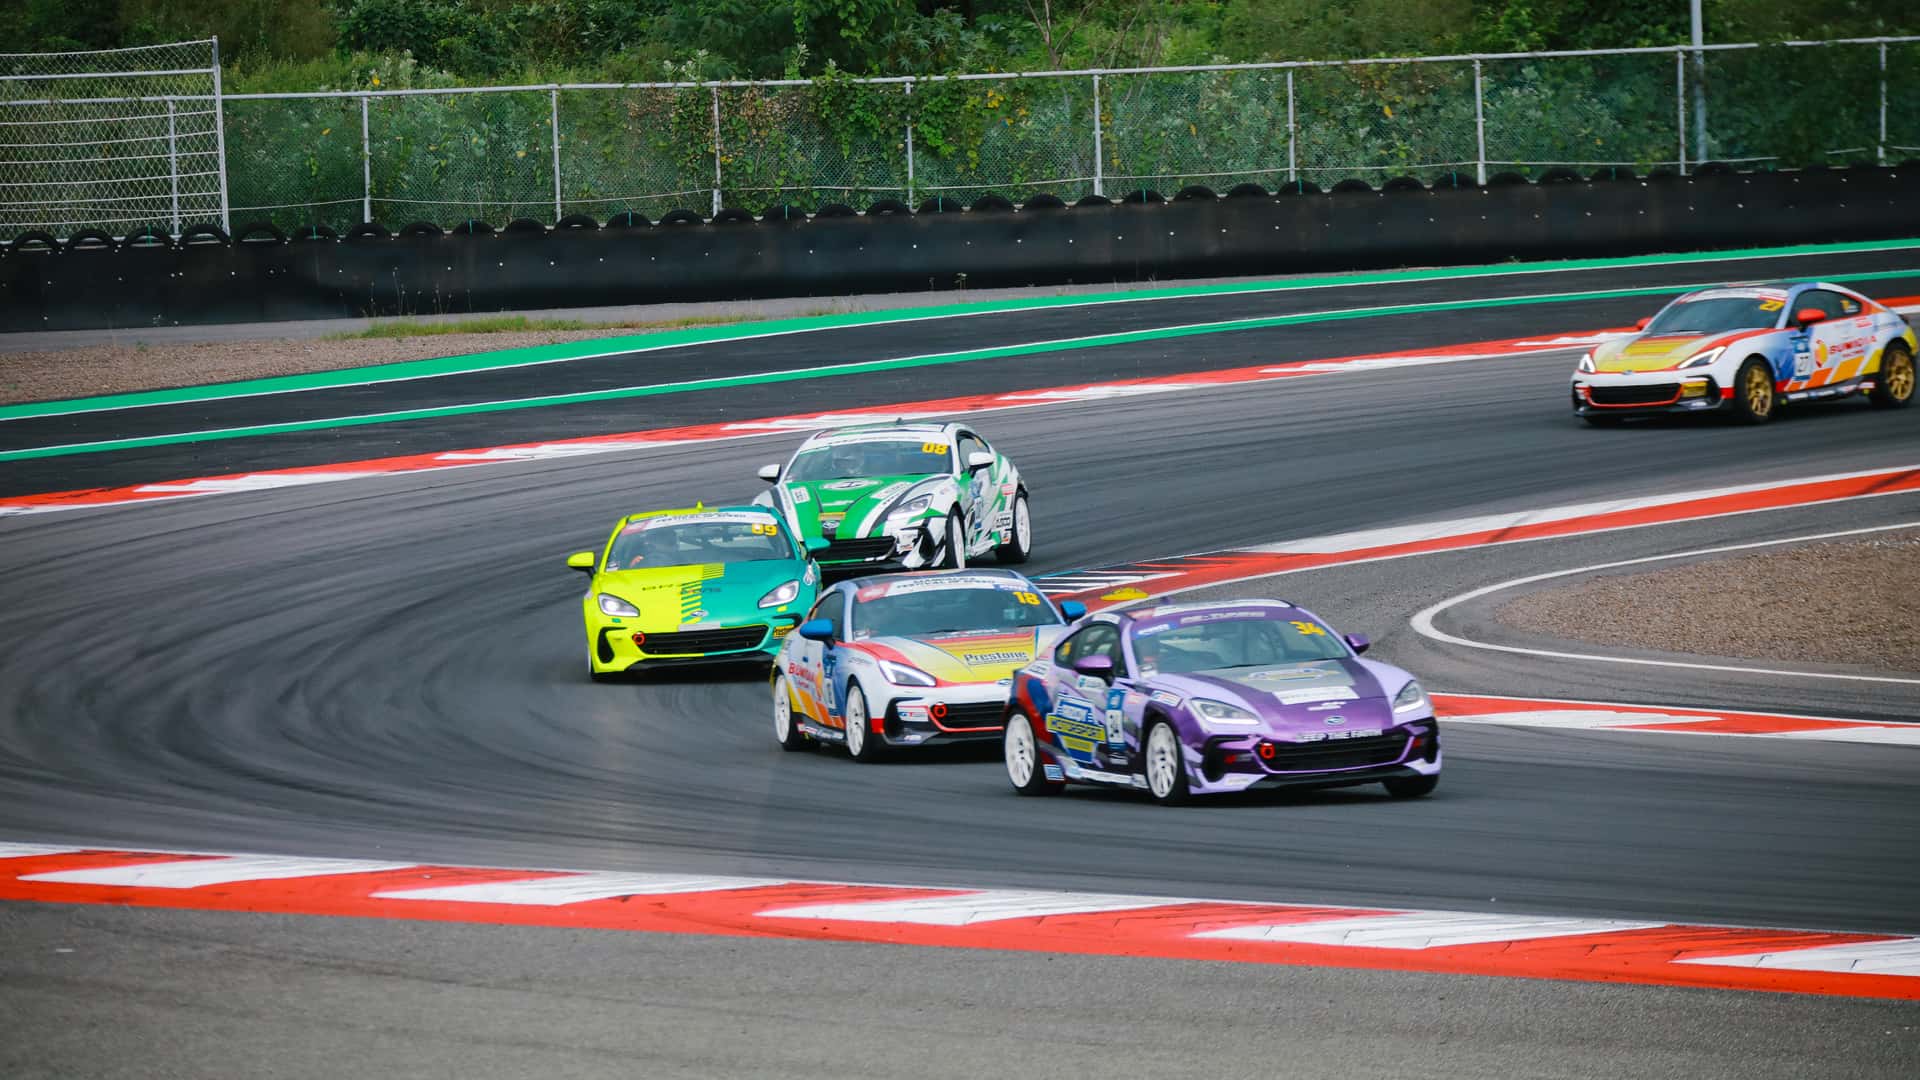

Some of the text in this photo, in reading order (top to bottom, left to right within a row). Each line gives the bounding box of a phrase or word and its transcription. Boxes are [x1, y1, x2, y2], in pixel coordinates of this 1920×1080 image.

[1012, 592, 1041, 605] 18
[1288, 621, 1326, 636] 34
[963, 651, 1028, 662] Prestone
